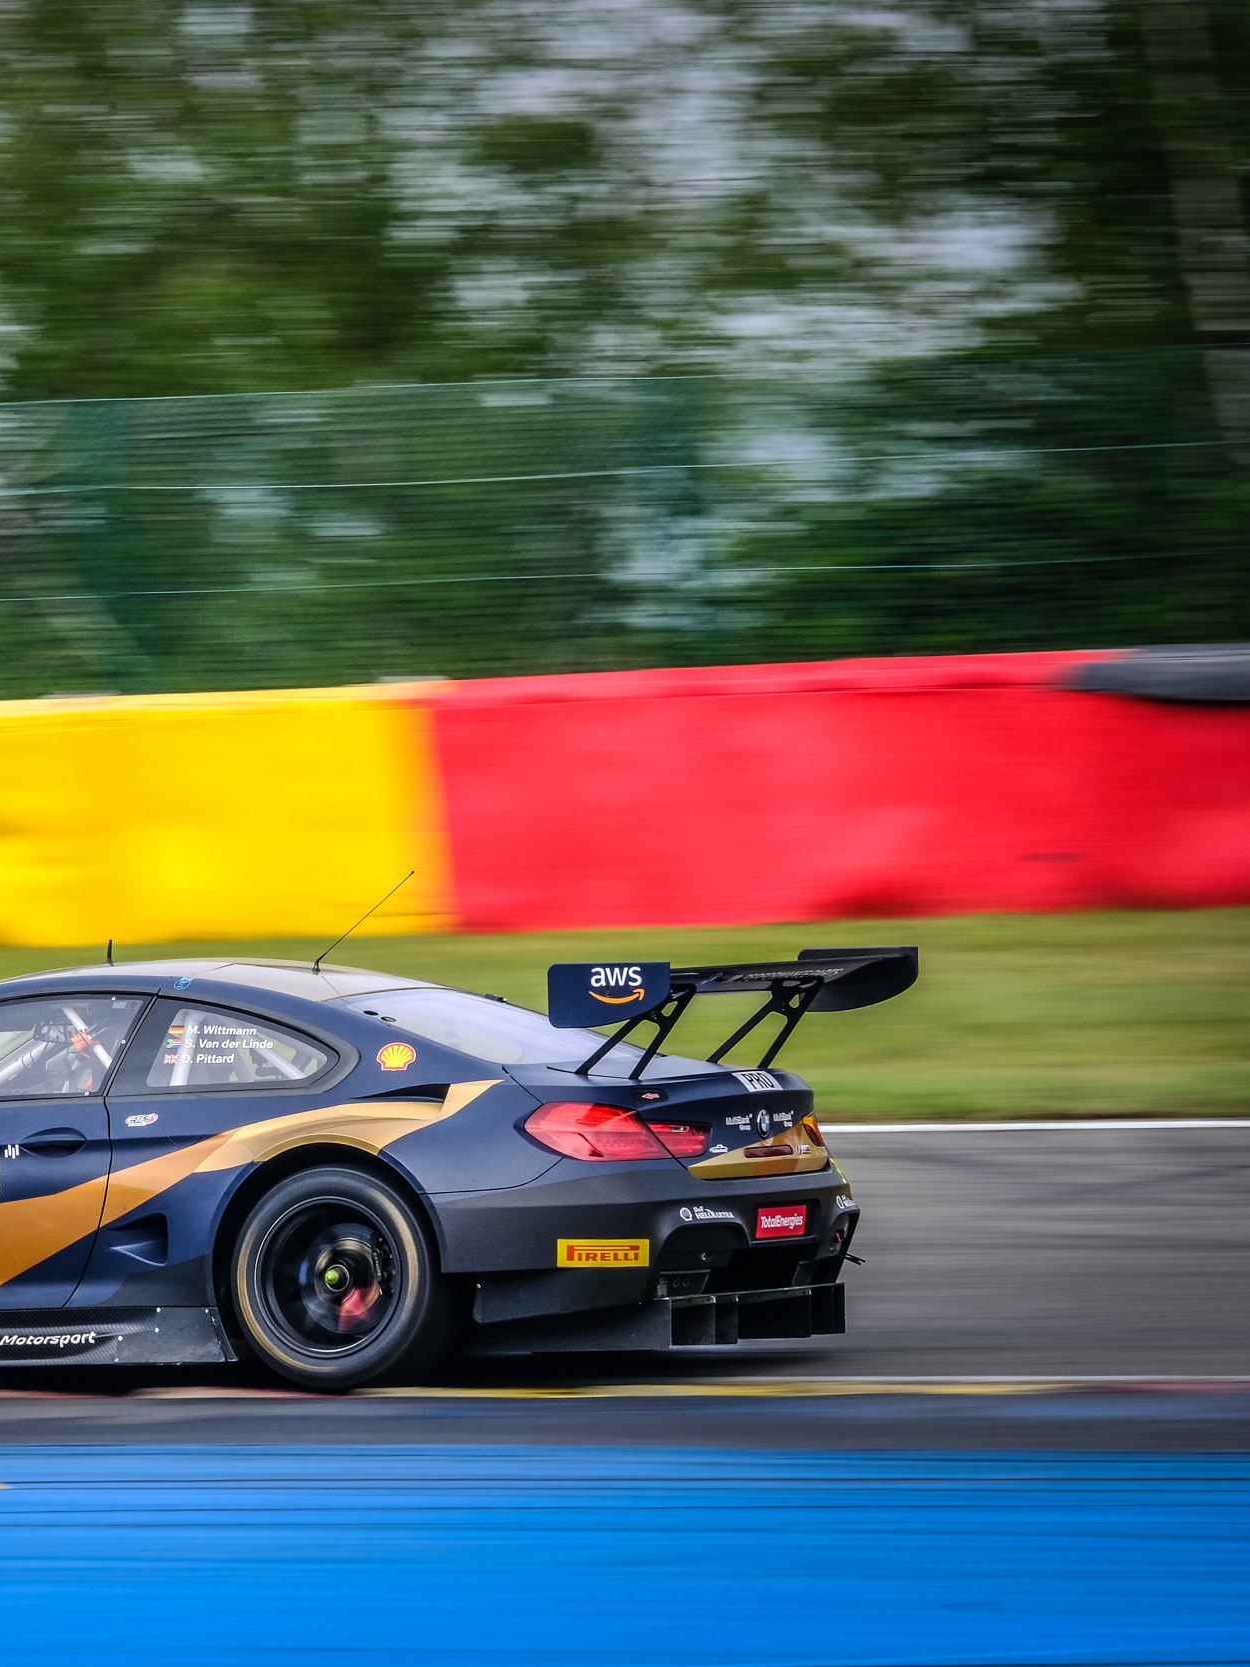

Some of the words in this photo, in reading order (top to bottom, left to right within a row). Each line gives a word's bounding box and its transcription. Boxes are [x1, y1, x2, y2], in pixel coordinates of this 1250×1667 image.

[590, 966, 643, 988] aws
[187, 1025, 201, 1035] M.
[203, 1025, 257, 1036] Wittmann
[184, 1039, 196, 1049] S.
[199, 1039, 219, 1049] Van
[221, 1038, 240, 1049] der
[242, 1038, 274, 1049] Linde
[196, 1053, 235, 1064] Pittard
[740, 1072, 775, 1090] PRO
[760, 1213, 804, 1230] TotalEnergies
[566, 1244, 641, 1262] PIRELLI
[0, 1331, 96, 1348] Motorsport
